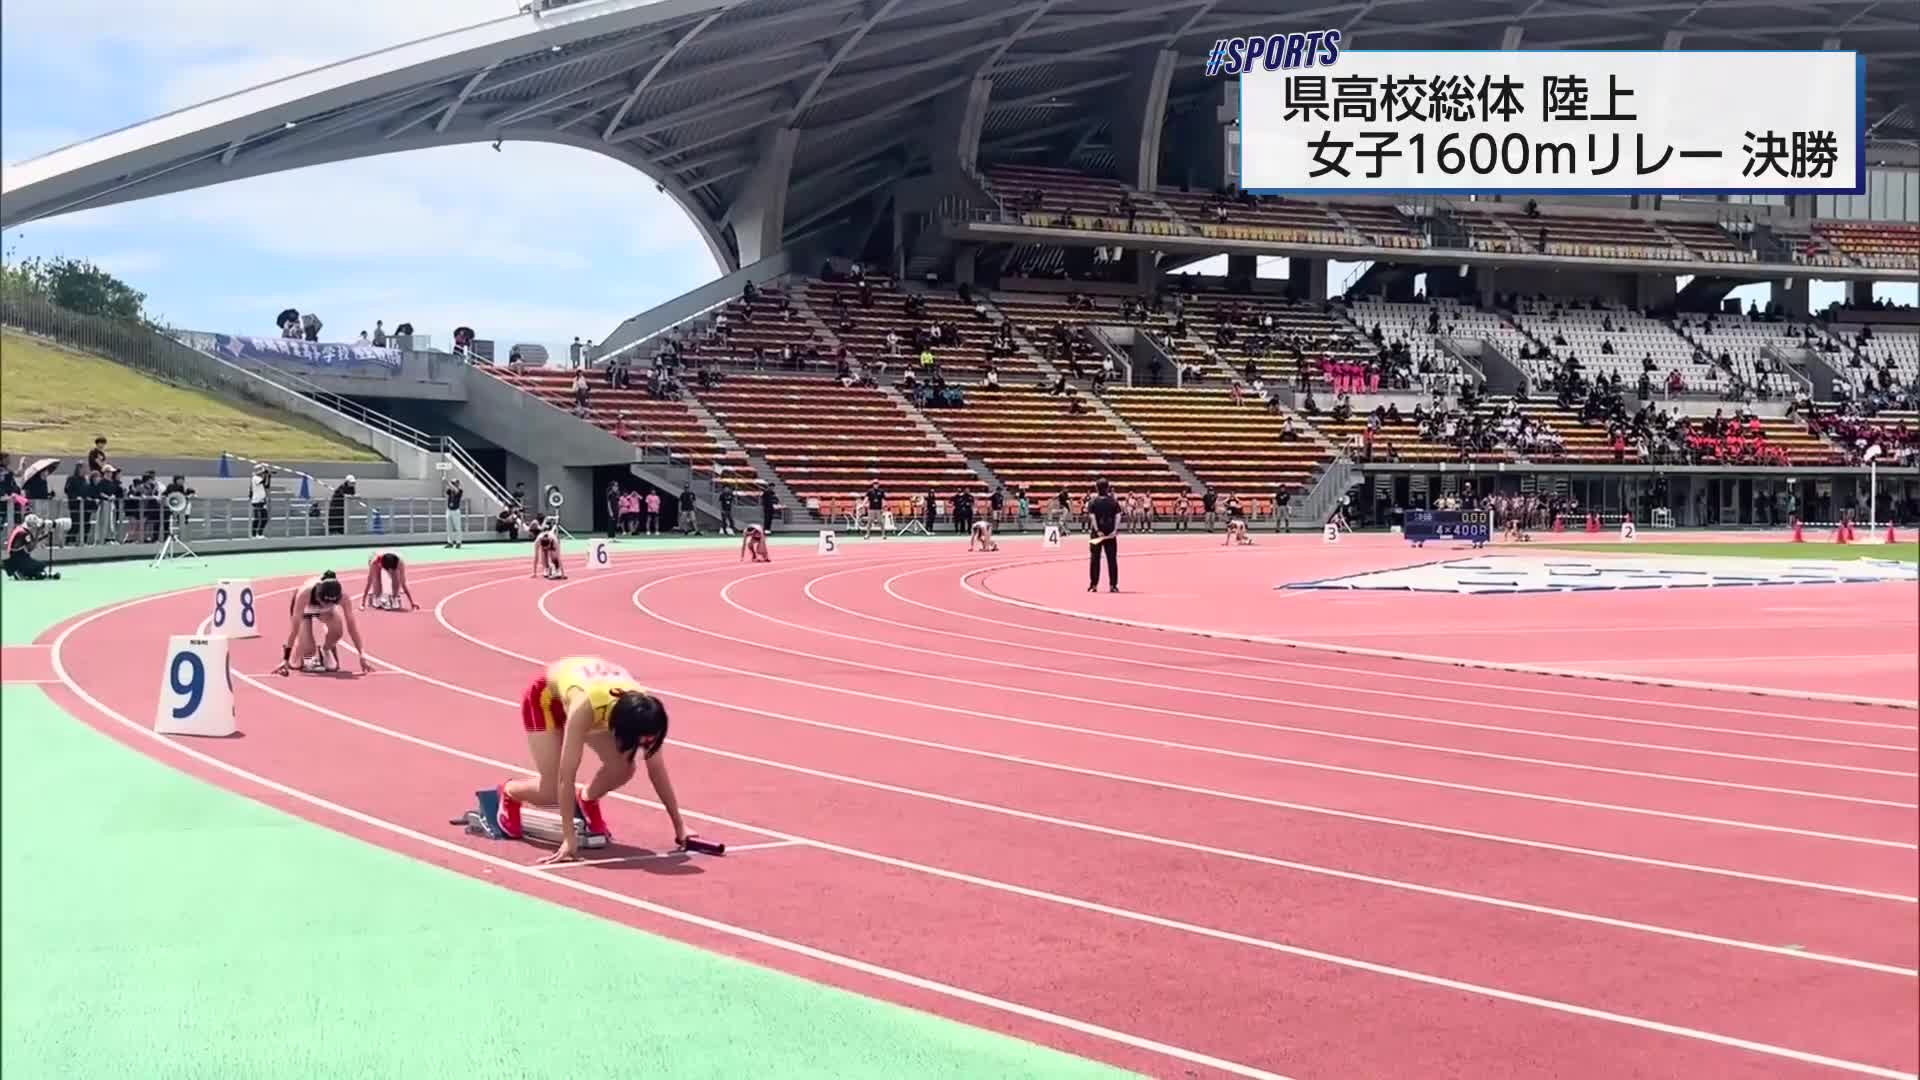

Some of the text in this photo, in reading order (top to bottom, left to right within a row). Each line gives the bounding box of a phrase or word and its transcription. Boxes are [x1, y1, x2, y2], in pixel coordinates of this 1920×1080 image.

[1048, 526, 1058, 545] 4
[1327, 526, 1337, 541] 3
[1625, 526, 1633, 539] 2
[825, 534, 835, 552] 5
[596, 543, 608, 565] 6
[214, 587, 255, 628] 8 8
[170, 650, 205, 719] 9
